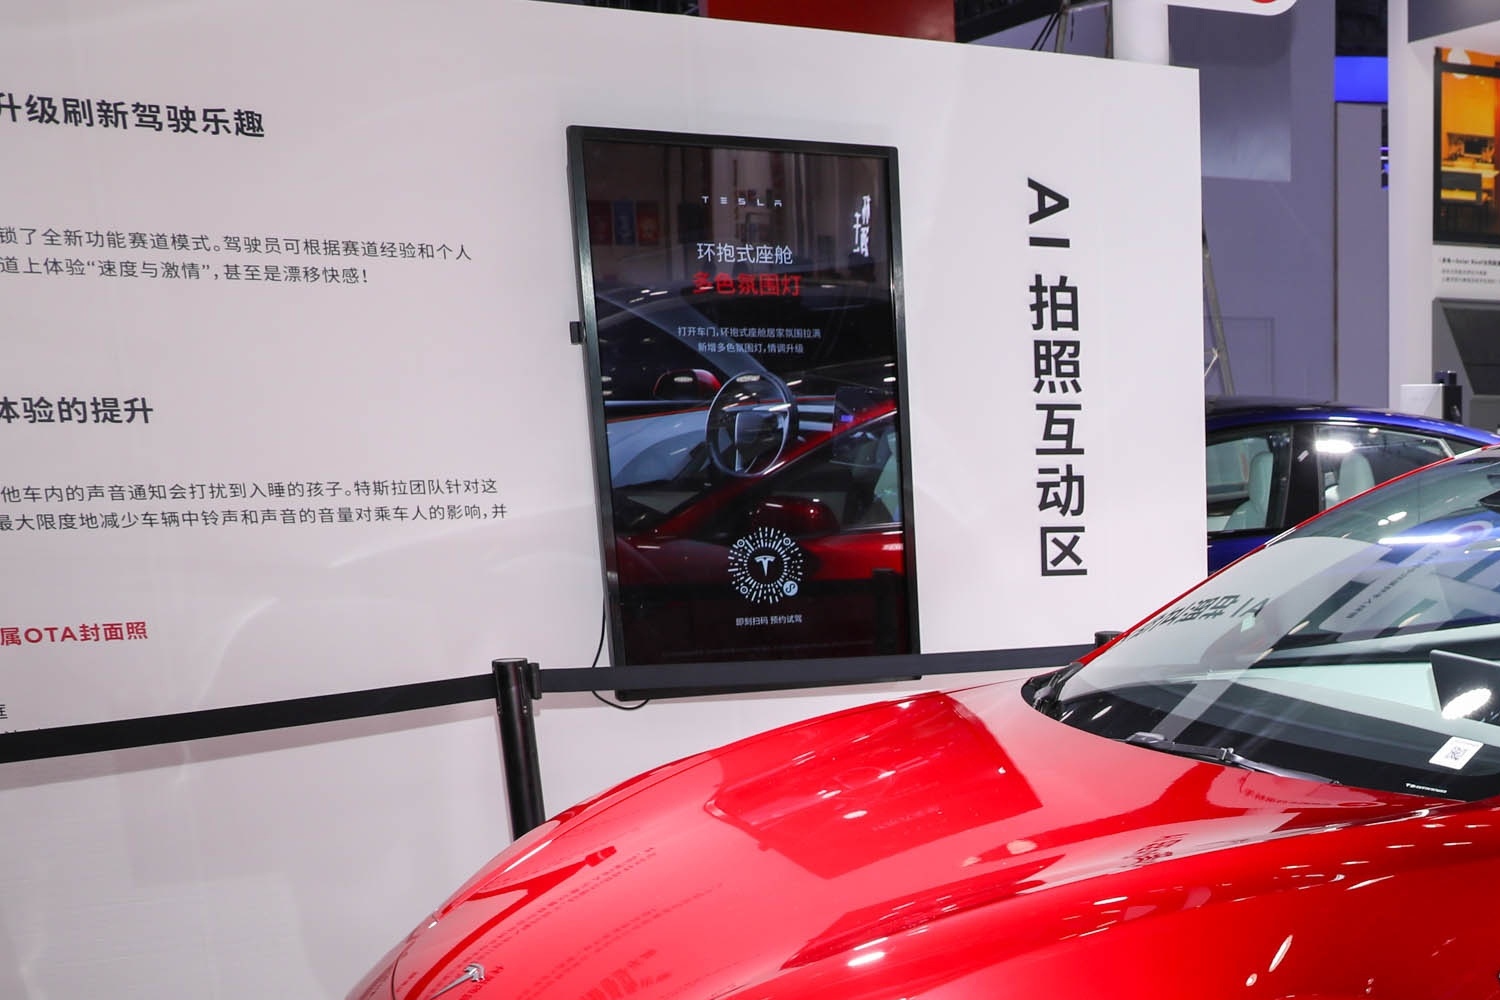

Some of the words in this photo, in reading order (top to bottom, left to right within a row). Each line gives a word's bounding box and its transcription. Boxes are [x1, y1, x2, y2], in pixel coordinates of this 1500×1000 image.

[0, 92, 265, 138] 升级刷新驾驶乐趣
[701, 195, 783, 207] TESLA
[696, 242, 793, 265] 环抱式座舱
[692, 271, 802, 296] 多色氛围灯
[0, 621, 148, 646] 属OTA封面照
